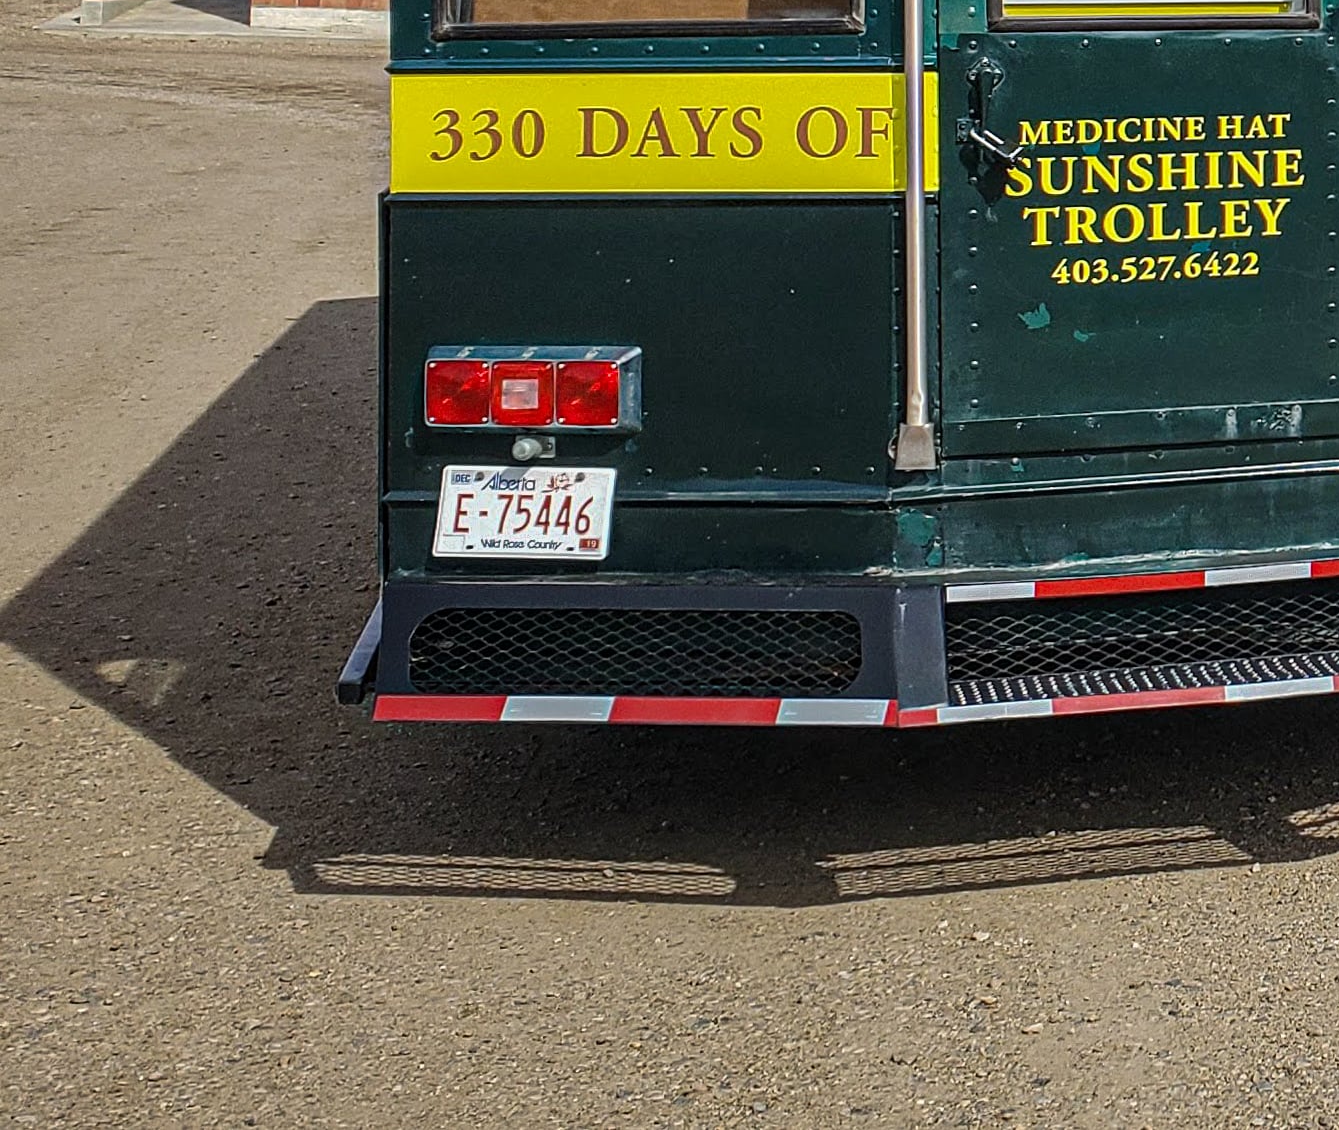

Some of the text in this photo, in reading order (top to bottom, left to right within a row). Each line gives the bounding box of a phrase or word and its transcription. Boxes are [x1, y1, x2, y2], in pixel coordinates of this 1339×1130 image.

[430, 106, 894, 162] 330 DAYS OF
[1018, 113, 1291, 146] MEDICINE HAT
[1004, 148, 1306, 198] SUNSHINE
[1022, 197, 1291, 246] TROLLEY
[1051, 251, 1260, 285] 403.527.6422
[455, 473, 471, 483] DEC
[481, 471, 536, 491] Alberta
[452, 493, 594, 535] E-75446
[481, 538, 563, 551] Wild Rose Country
